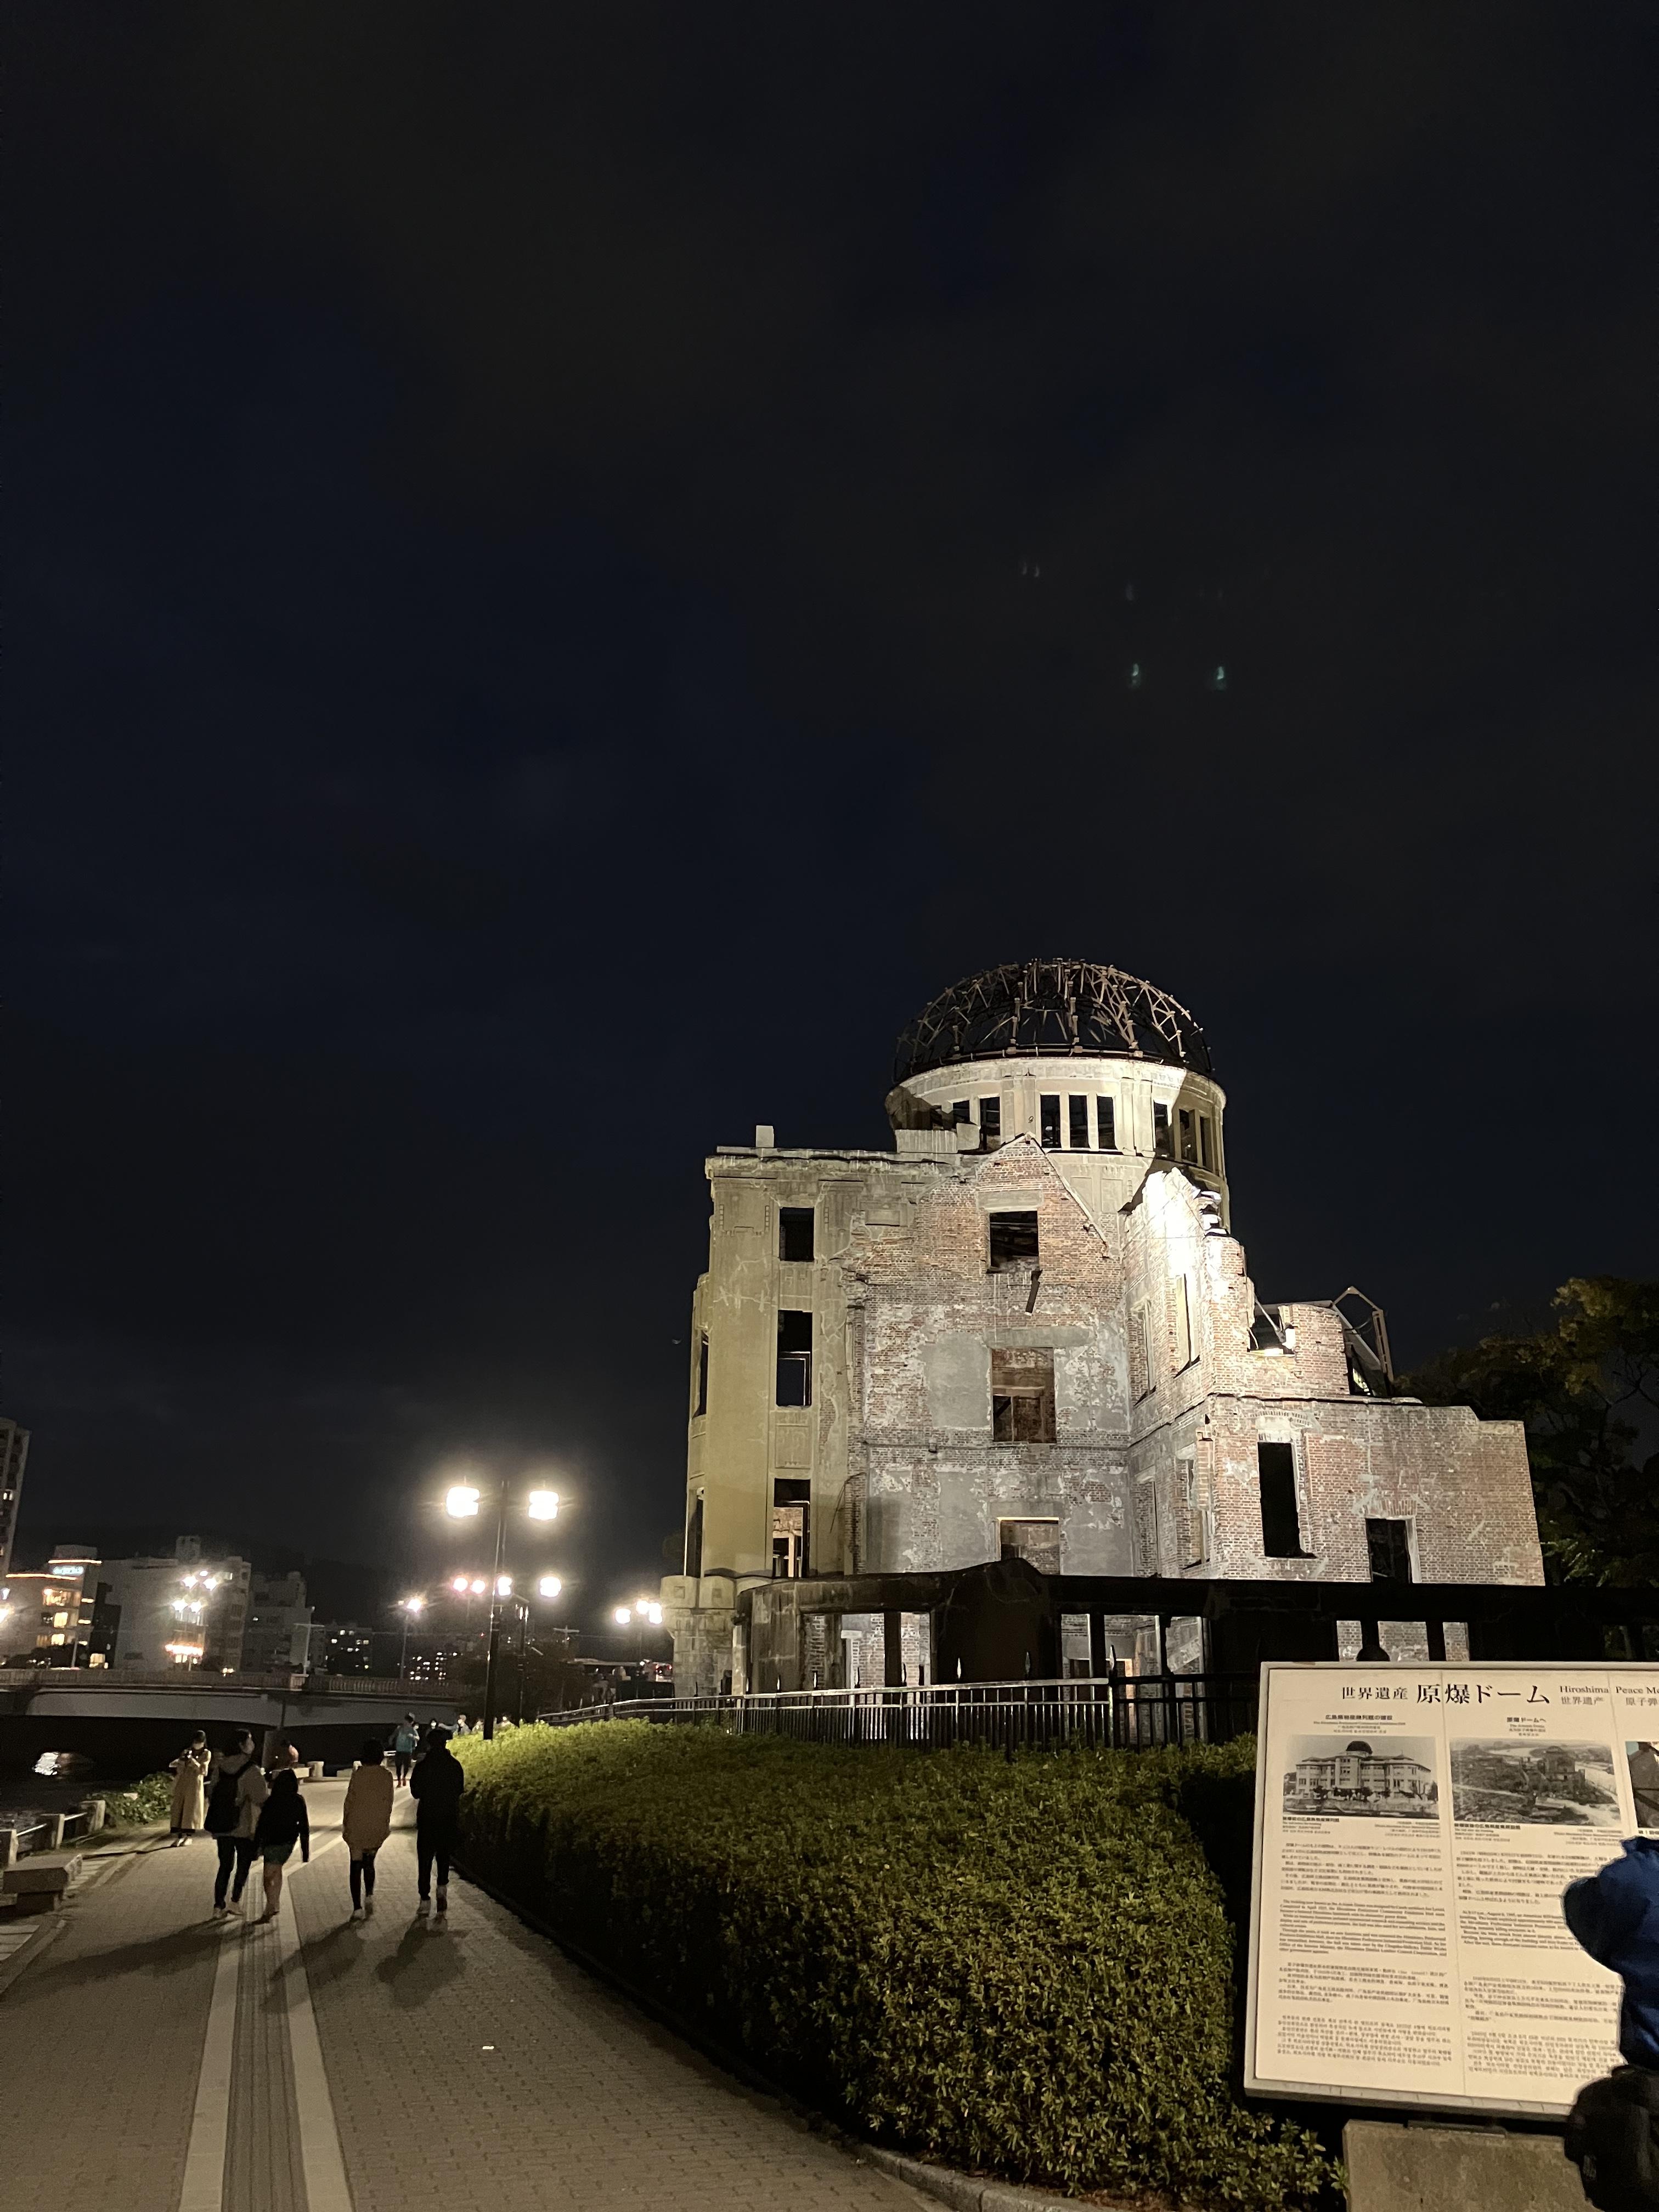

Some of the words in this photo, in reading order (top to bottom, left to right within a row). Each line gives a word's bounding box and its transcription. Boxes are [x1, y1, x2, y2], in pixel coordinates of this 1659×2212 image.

[1342, 1686, 1408, 1700] 世界遺産
[1417, 1683, 1550, 1704] 原爆ドーム
[1616, 1686, 1644, 1694] Peace
